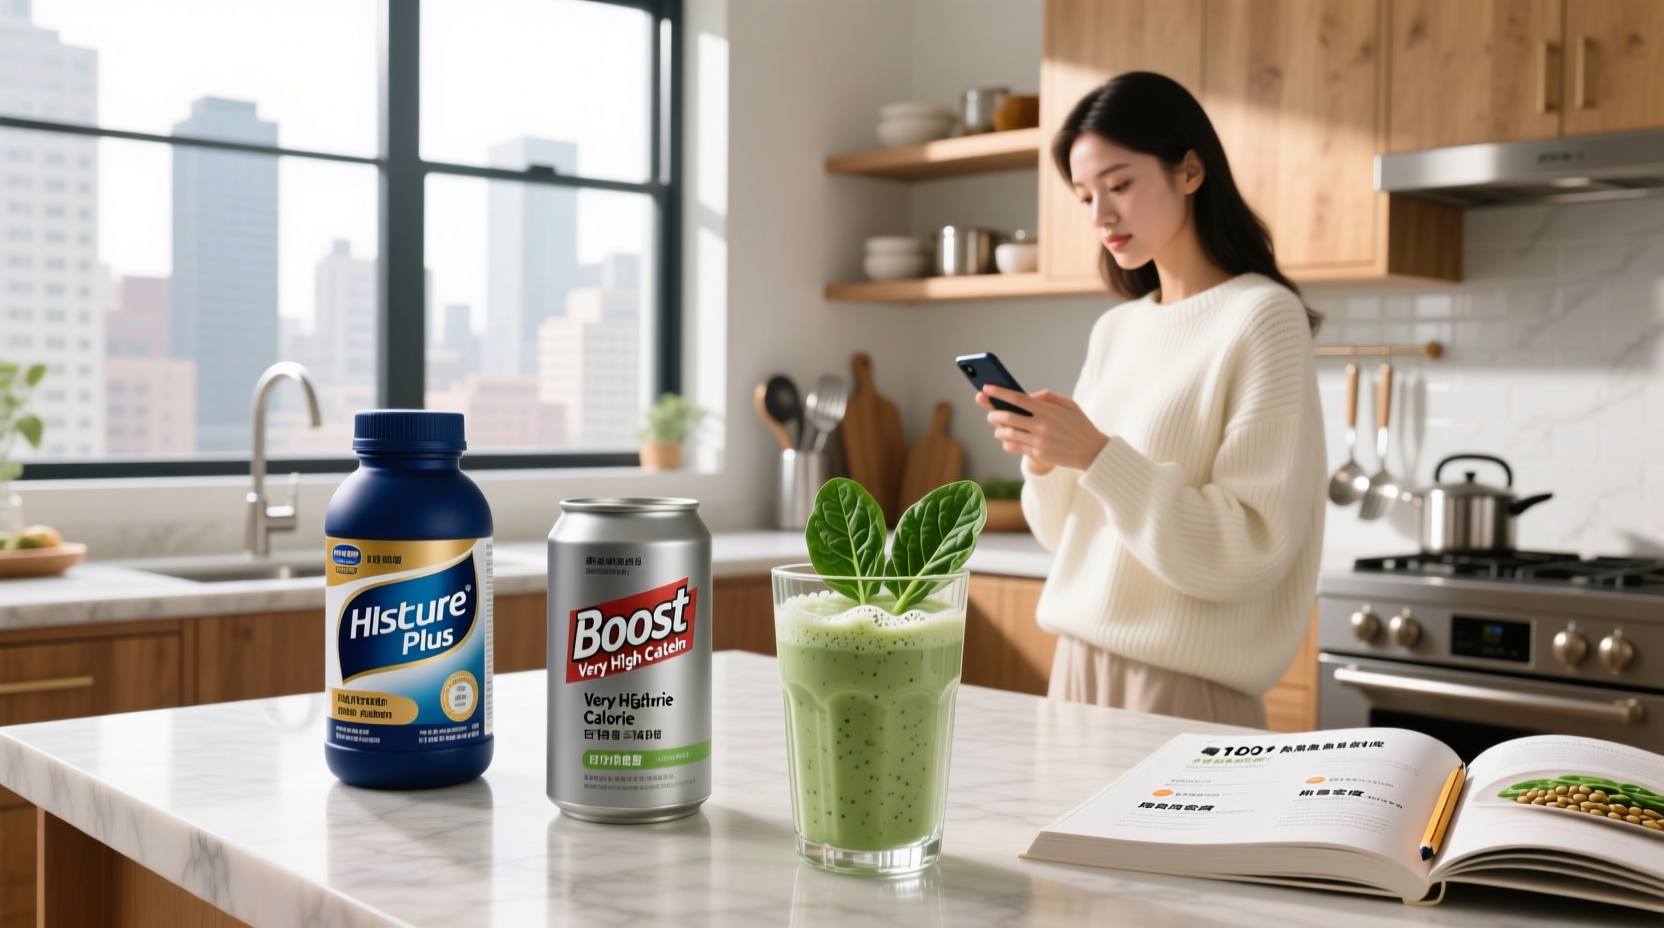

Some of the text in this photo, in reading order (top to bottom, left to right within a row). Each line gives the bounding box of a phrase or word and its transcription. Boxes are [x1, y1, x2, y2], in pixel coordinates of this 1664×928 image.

[572, 586, 690, 661] Boost
[402, 628, 453, 655] Plus
[578, 661, 608, 678] Very
[584, 692, 616, 710] Very
[583, 709, 635, 726] Calorie
